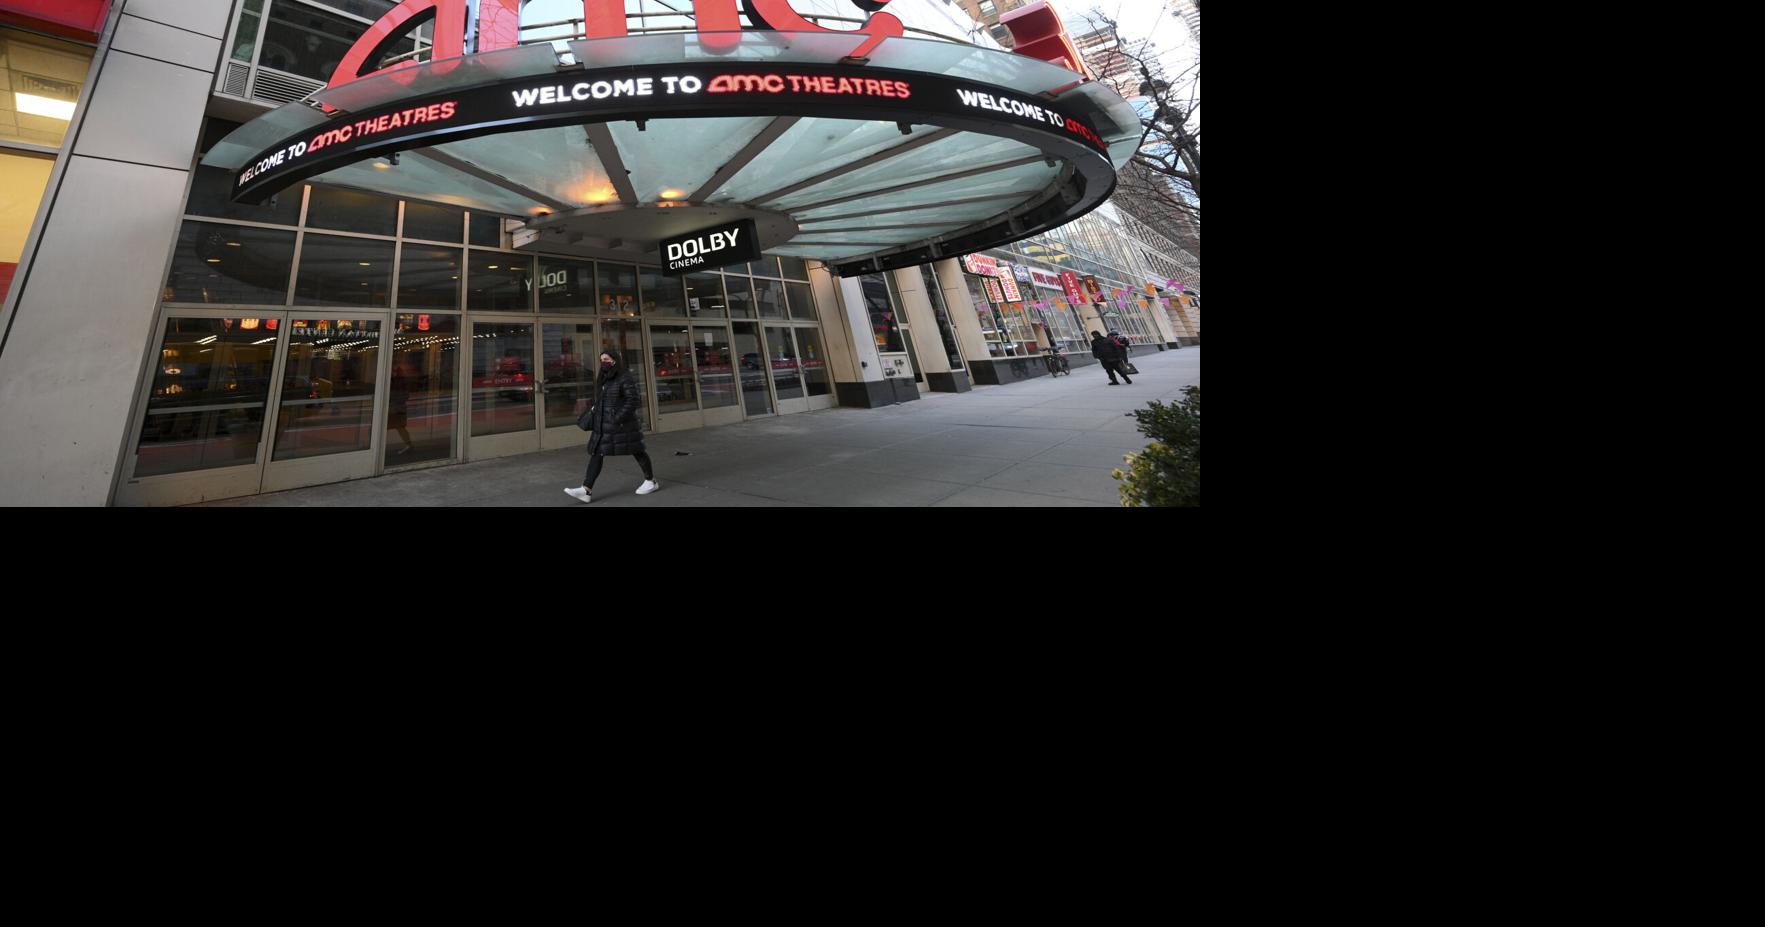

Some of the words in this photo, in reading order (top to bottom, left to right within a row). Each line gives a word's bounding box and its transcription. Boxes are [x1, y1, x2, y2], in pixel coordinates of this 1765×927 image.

[511, 77, 654, 108] WELCOME
[661, 75, 702, 94] TO
[786, 75, 911, 99] THEATRES
[956, 88, 1046, 123] WELCOME
[1044, 109, 1065, 128] TO
[238, 149, 286, 188] WELCOME
[288, 141, 307, 160] TO
[354, 101, 456, 138] THEATRES
[667, 227, 740, 261] DOLBY
[669, 255, 705, 270] CINEMA
